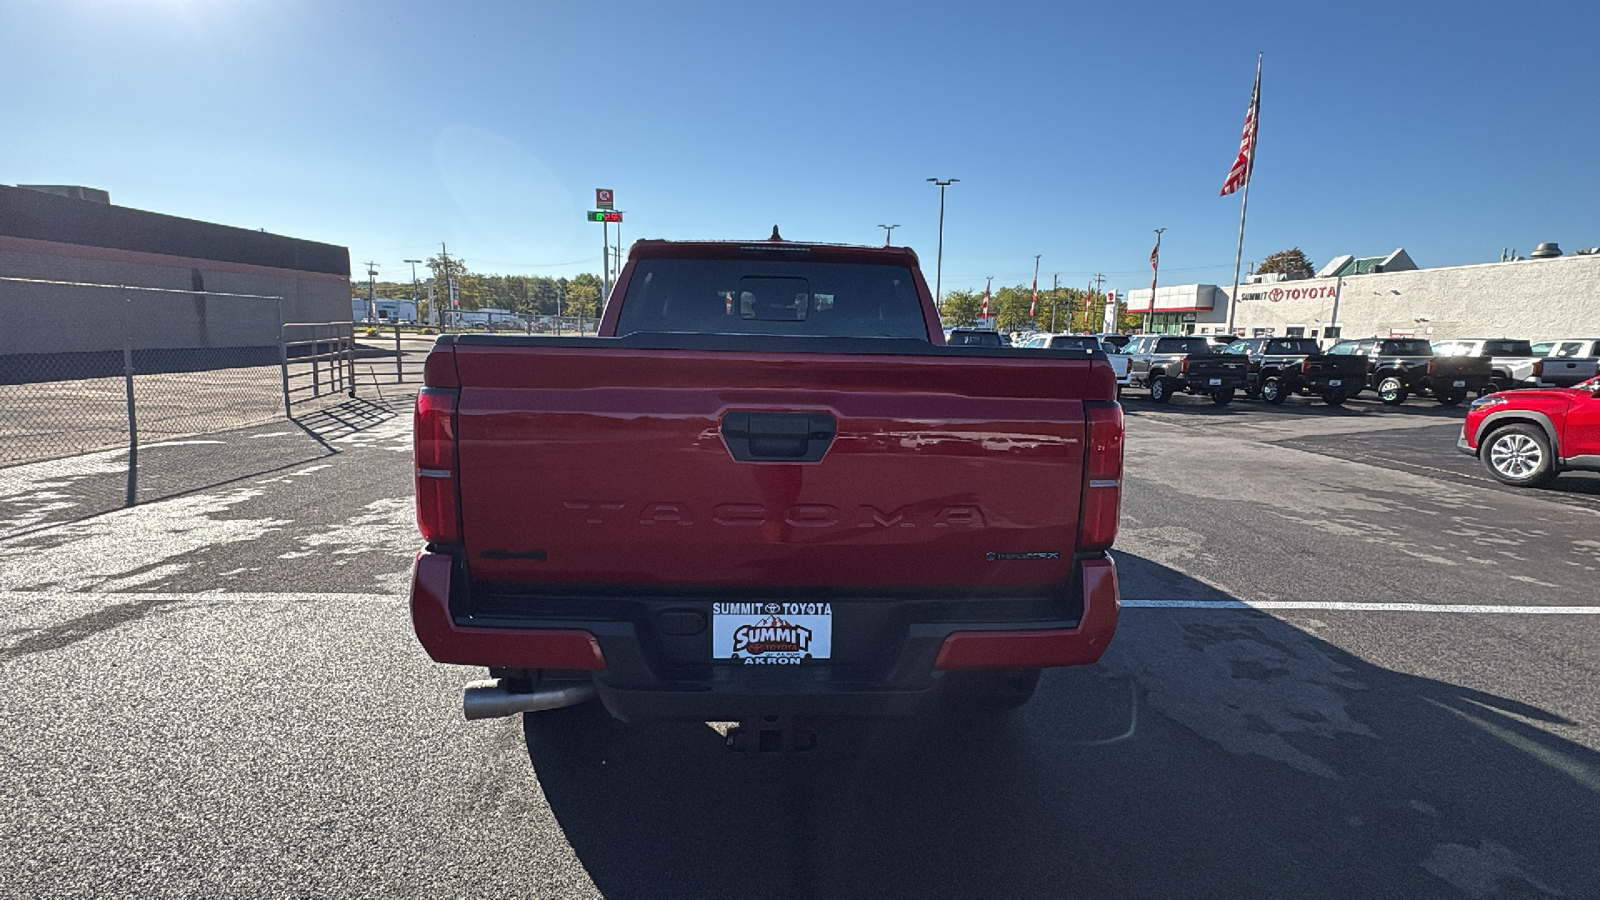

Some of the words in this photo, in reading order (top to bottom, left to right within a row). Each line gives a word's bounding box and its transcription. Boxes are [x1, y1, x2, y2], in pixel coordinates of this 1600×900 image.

[1241, 291, 1268, 301] SUMMIT
[1284, 286, 1336, 300] TOYOTA
[562, 502, 986, 528] TACOMA
[712, 602, 764, 615] SUMMIT
[782, 602, 832, 615] TOYOTA
[735, 626, 810, 650] SUMMIT
[743, 657, 801, 665] AKRON
